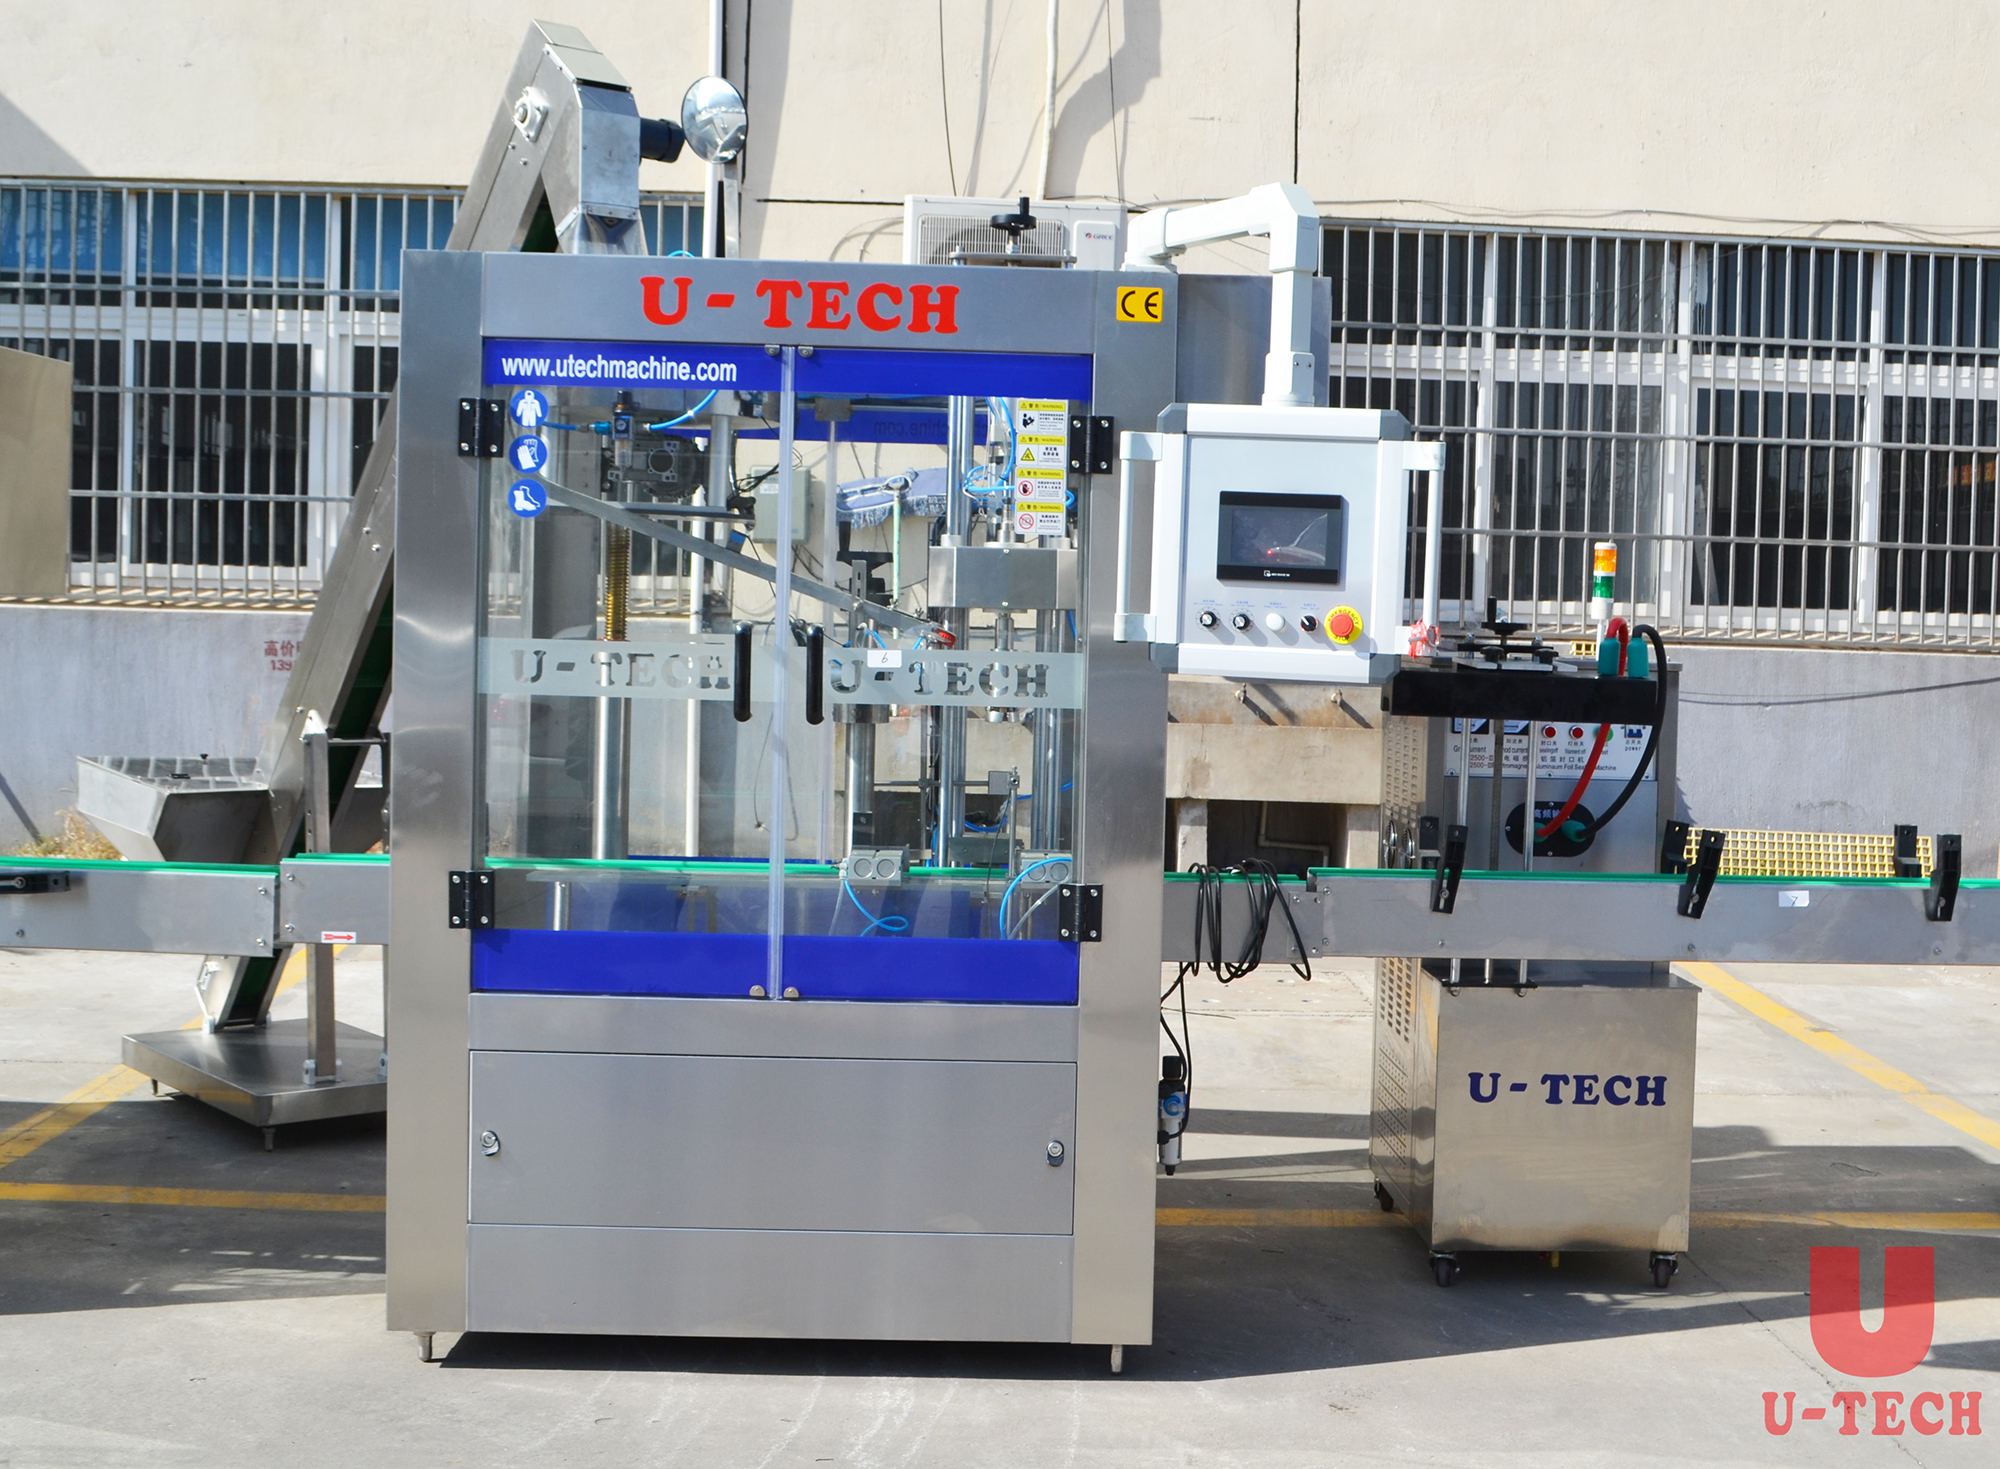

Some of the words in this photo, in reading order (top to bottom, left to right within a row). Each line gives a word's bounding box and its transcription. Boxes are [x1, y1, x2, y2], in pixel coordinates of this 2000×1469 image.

[502, 354, 737, 382] www.utechmachine.com
[881, 652, 888, 663] 6
[1791, 895, 1799, 907] 7
